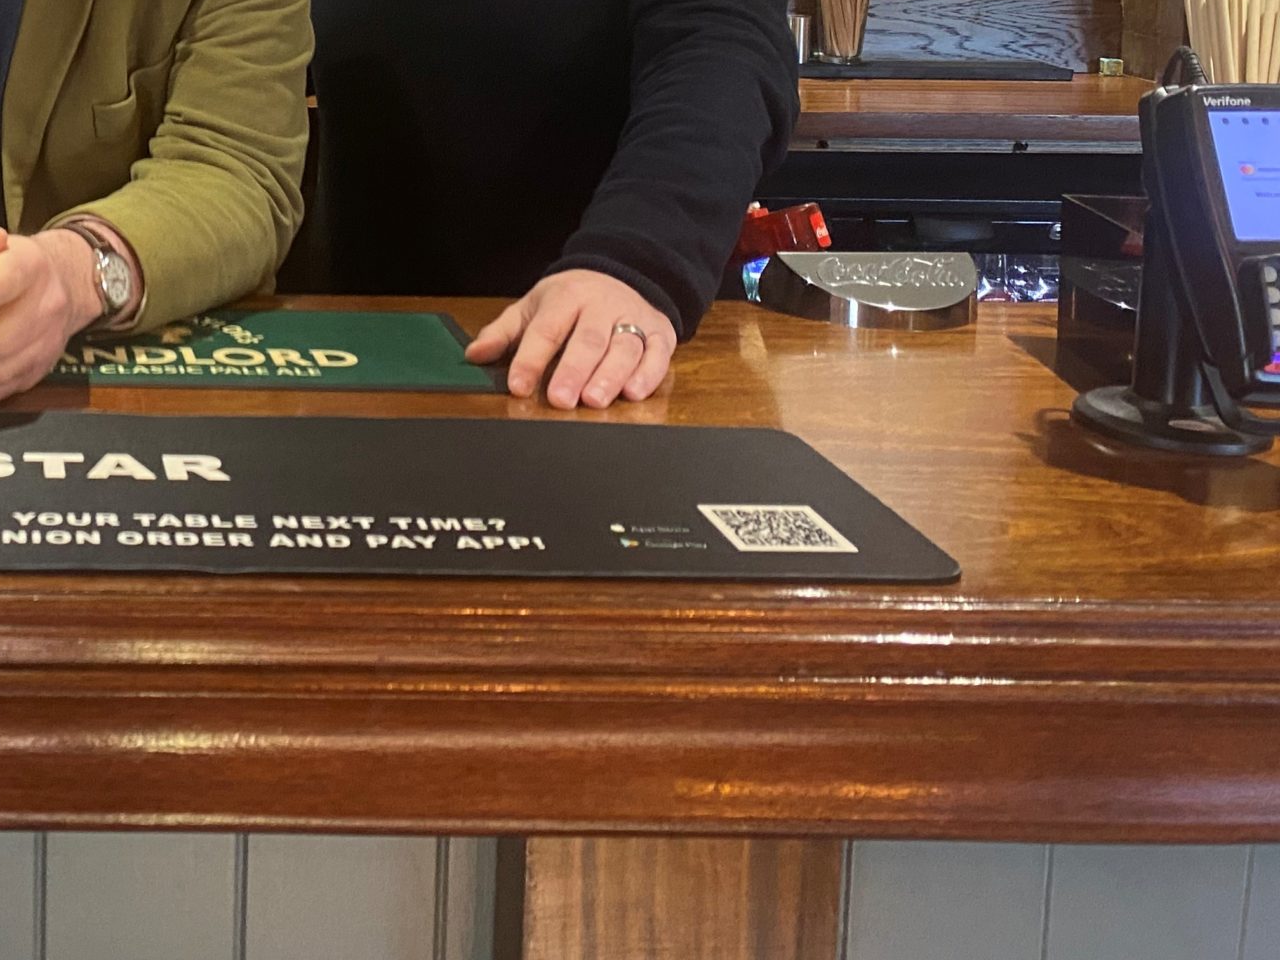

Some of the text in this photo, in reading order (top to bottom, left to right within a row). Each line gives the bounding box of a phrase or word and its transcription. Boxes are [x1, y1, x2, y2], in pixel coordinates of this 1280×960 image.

[1203, 96, 1251, 106] Verifone
[99, 364, 203, 375] CLASSIC
[209, 366, 269, 376] PALE
[275, 367, 322, 377] ALE
[12, 511, 120, 527] YOUR
[133, 513, 258, 528] TABLE
[272, 515, 375, 530] NEXT
[389, 516, 506, 531] TIME?
[117, 531, 255, 548] ORDER
[269, 533, 352, 549] AND
[366, 534, 437, 550] PAY
[456, 536, 546, 551] APP!
